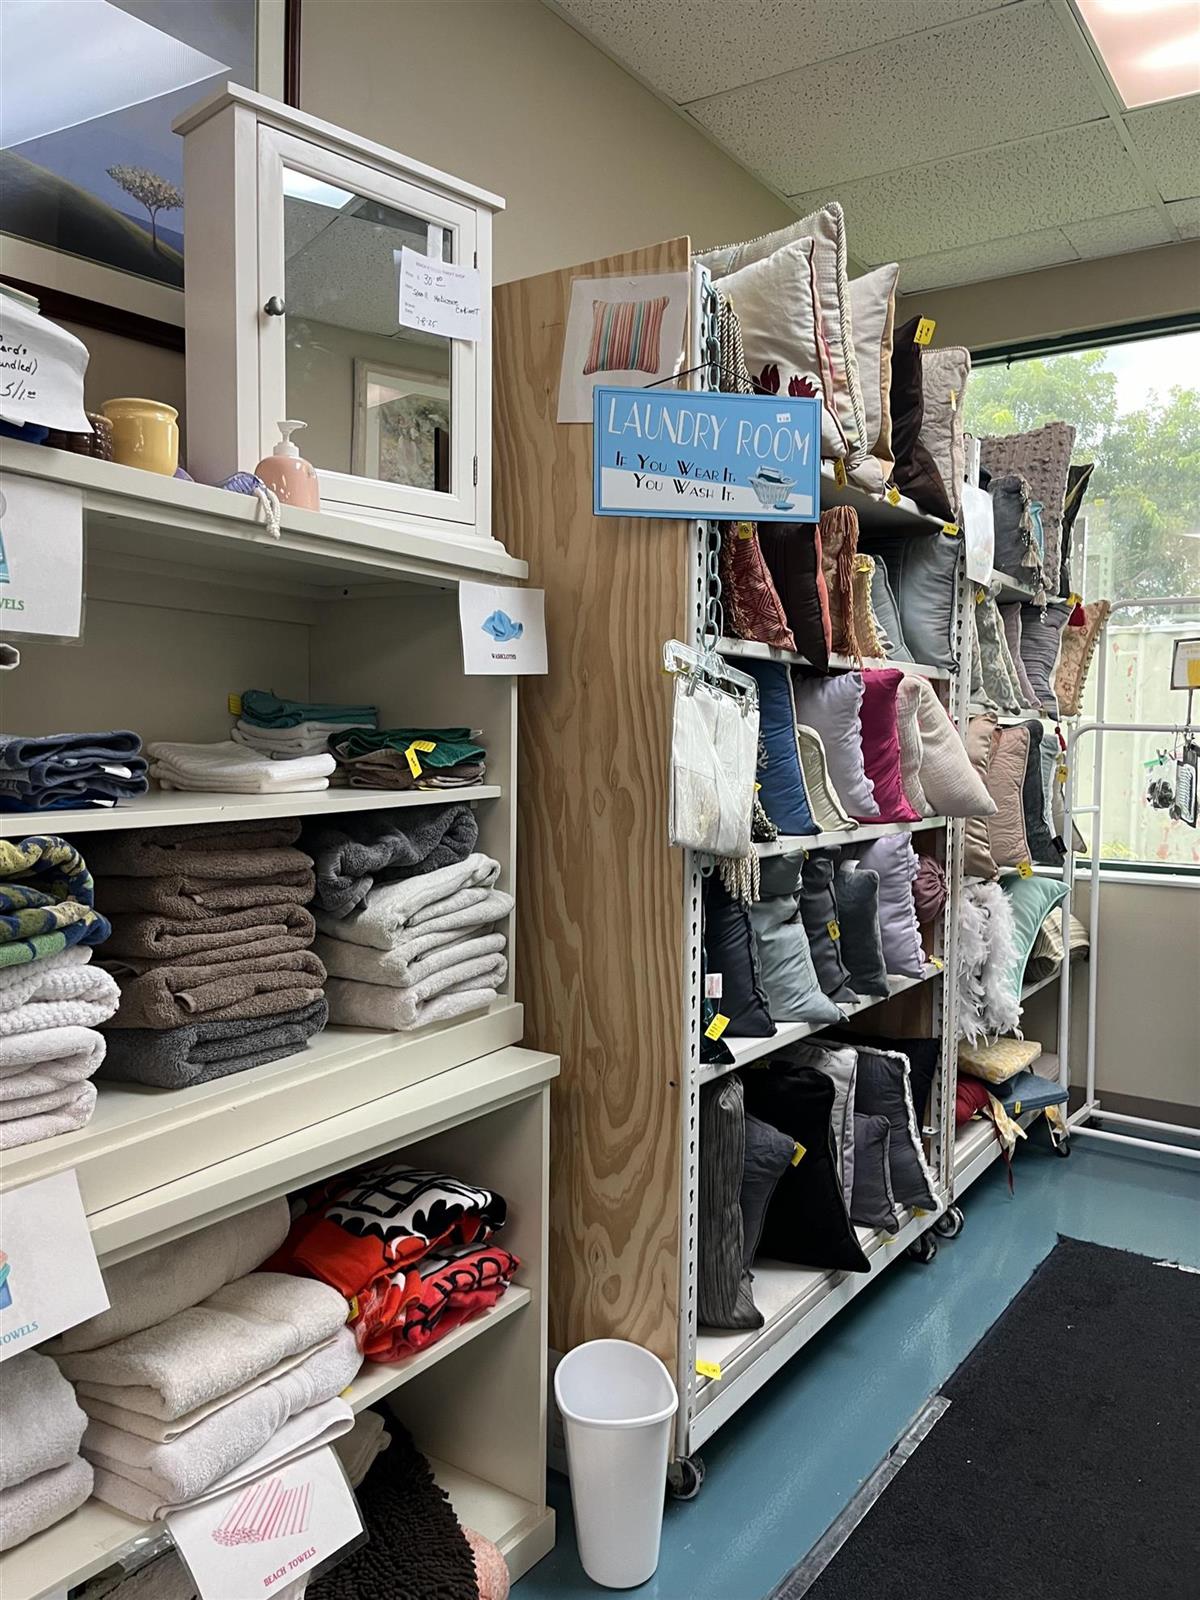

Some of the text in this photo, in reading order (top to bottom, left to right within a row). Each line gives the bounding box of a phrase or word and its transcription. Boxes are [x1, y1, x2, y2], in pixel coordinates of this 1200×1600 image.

[608, 397, 810, 466] LAUNDRY ROOM
[616, 451, 628, 466] IF
[637, 453, 668, 473] YOU
[677, 459, 719, 481] WEAR
[633, 472, 664, 491] YOU
[673, 478, 714, 499] WASH
[263, 1546, 317, 1587] BEACH TOWELS
